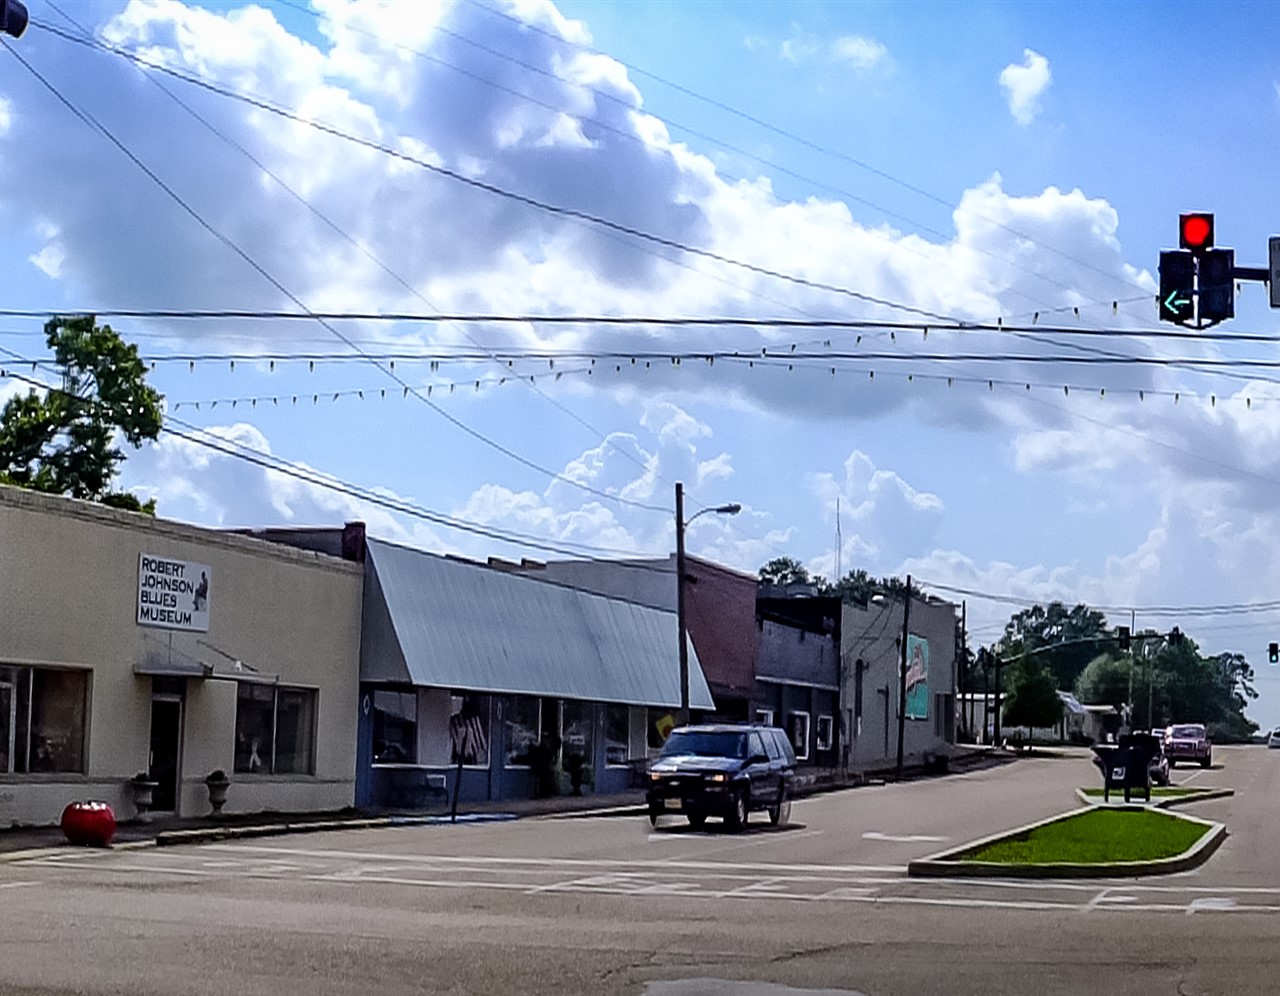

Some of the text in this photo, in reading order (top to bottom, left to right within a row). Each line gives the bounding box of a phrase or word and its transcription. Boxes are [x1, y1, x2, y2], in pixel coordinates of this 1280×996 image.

[142, 557, 186, 578] ROBERT
[141, 574, 194, 595] JOHNSON
[140, 590, 177, 608] BLUES
[140, 605, 192, 626] MUSEUM
